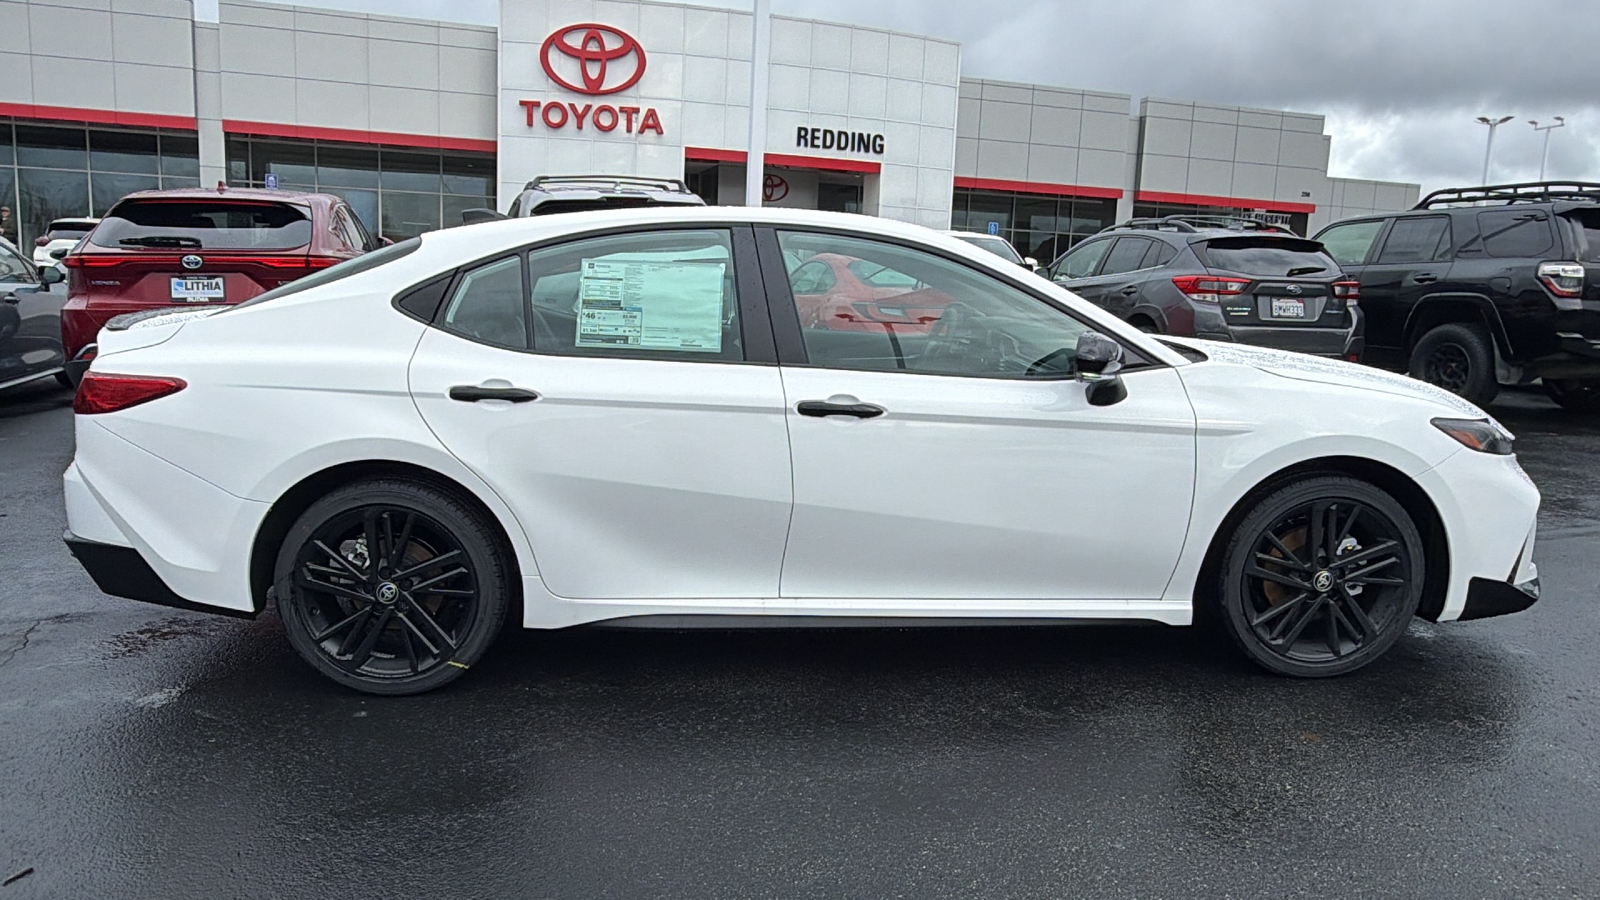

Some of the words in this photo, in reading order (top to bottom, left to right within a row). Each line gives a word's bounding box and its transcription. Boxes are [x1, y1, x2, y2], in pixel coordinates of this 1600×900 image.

[519, 100, 664, 135] TOYOTA
[796, 126, 885, 154] REDDING
[184, 281, 222, 291] LITHIA
